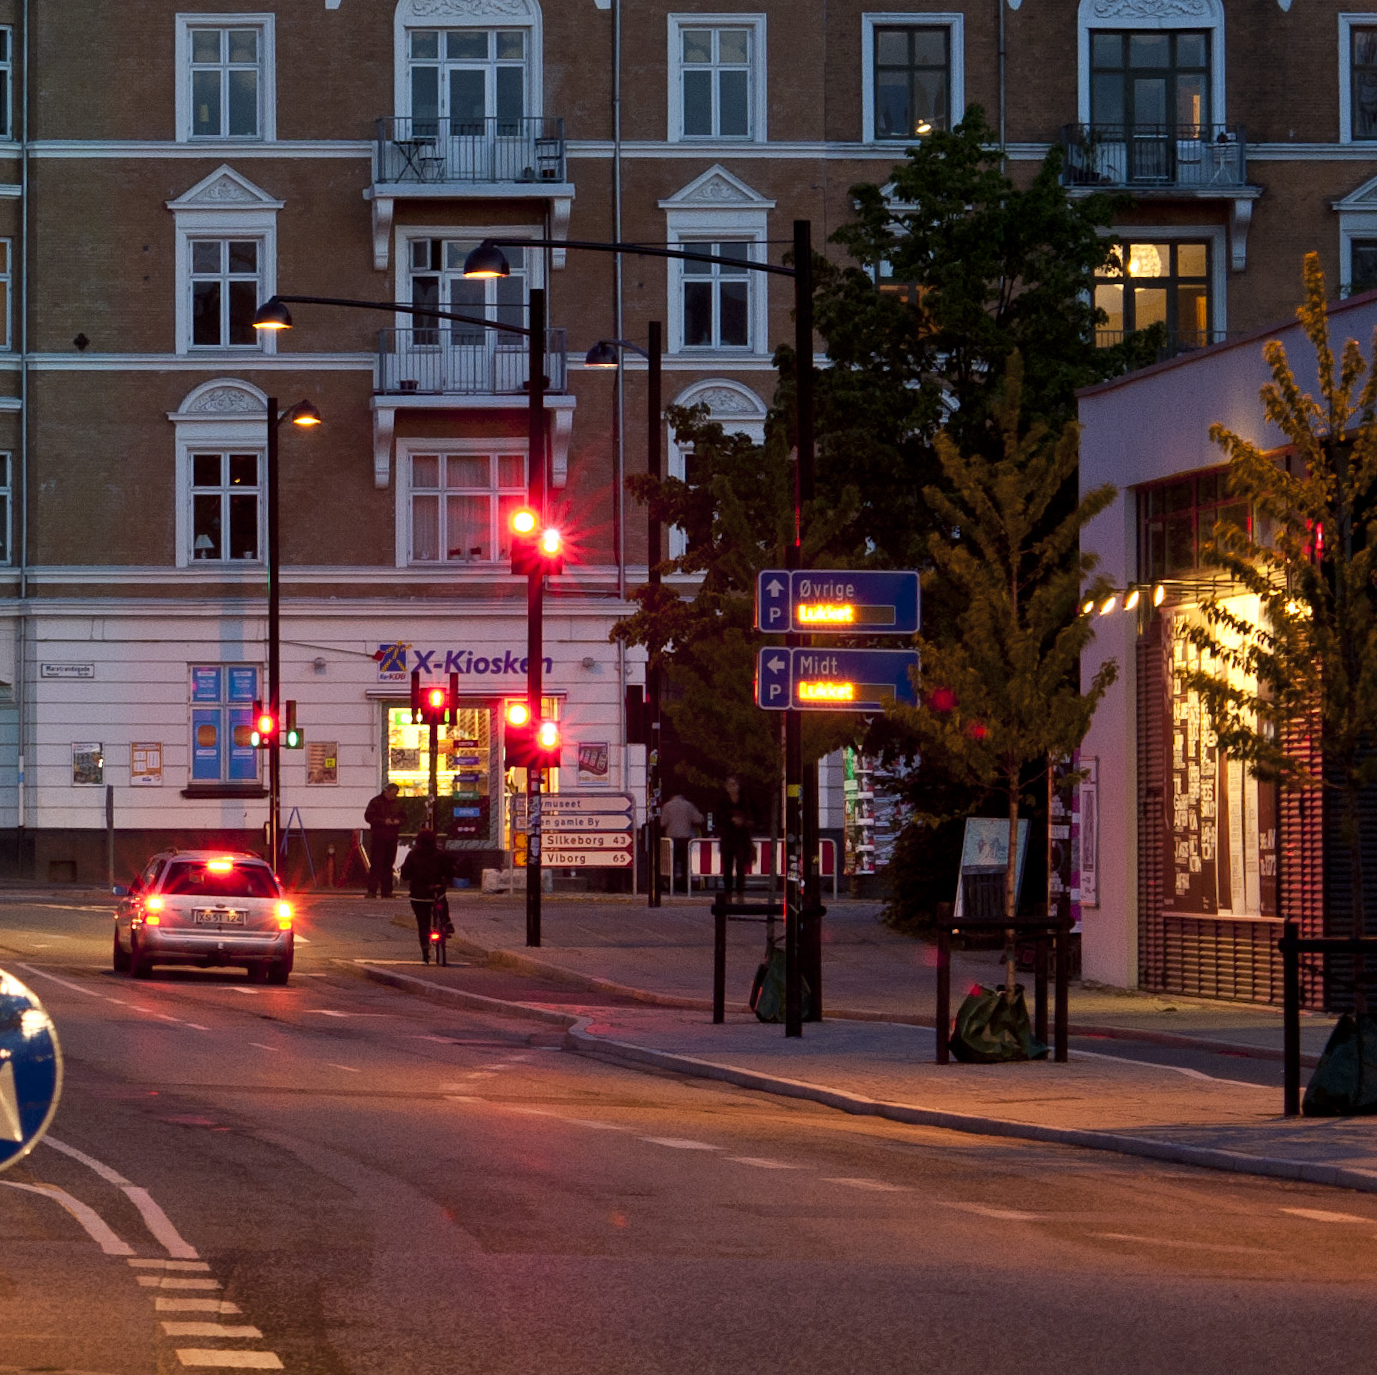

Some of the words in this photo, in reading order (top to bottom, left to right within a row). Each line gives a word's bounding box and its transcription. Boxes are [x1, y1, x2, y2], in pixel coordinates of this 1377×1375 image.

[799, 579, 855, 601] Øvrige
[769, 608, 781, 623] P
[798, 604, 854, 622] Lukket
[800, 656, 838, 675] Midt
[769, 685, 782, 700] P
[798, 681, 854, 700] Lukket
[541, 800, 581, 808] museet
[554, 816, 584, 827] gamle
[587, 816, 600, 826] By
[547, 835, 604, 845] Silkeborg
[612, 836, 626, 844] 43
[547, 853, 586, 864] Viborg
[612, 854, 626, 862] 65
